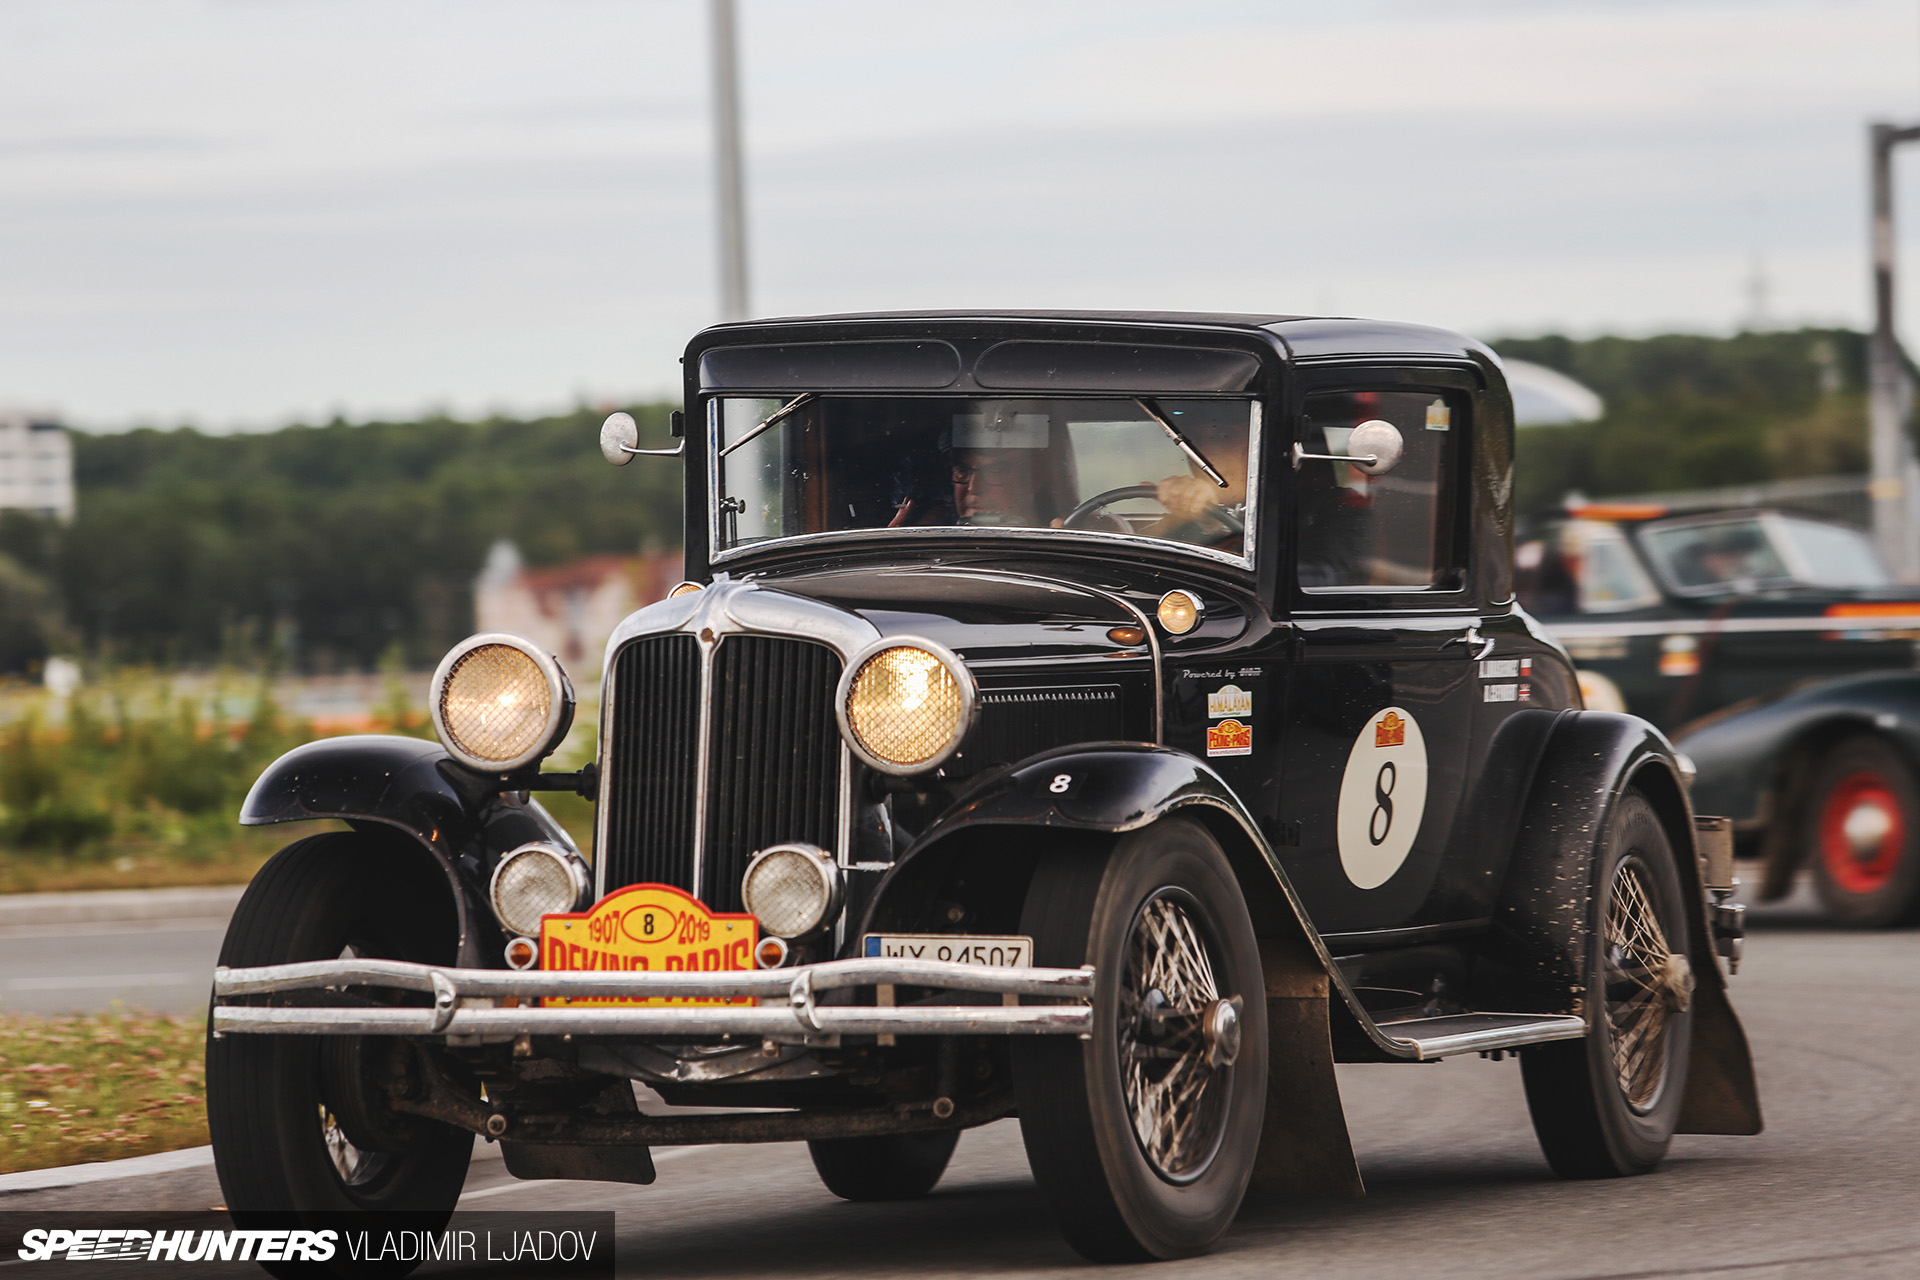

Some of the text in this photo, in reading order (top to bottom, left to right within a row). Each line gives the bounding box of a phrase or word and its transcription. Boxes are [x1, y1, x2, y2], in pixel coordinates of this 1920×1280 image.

[1182, 669, 1222, 679] Powered
[1225, 669, 1236, 680] by
[1049, 773, 1072, 793] 8
[1369, 761, 1397, 846] 8
[588, 910, 710, 945] 1907 8 2019
